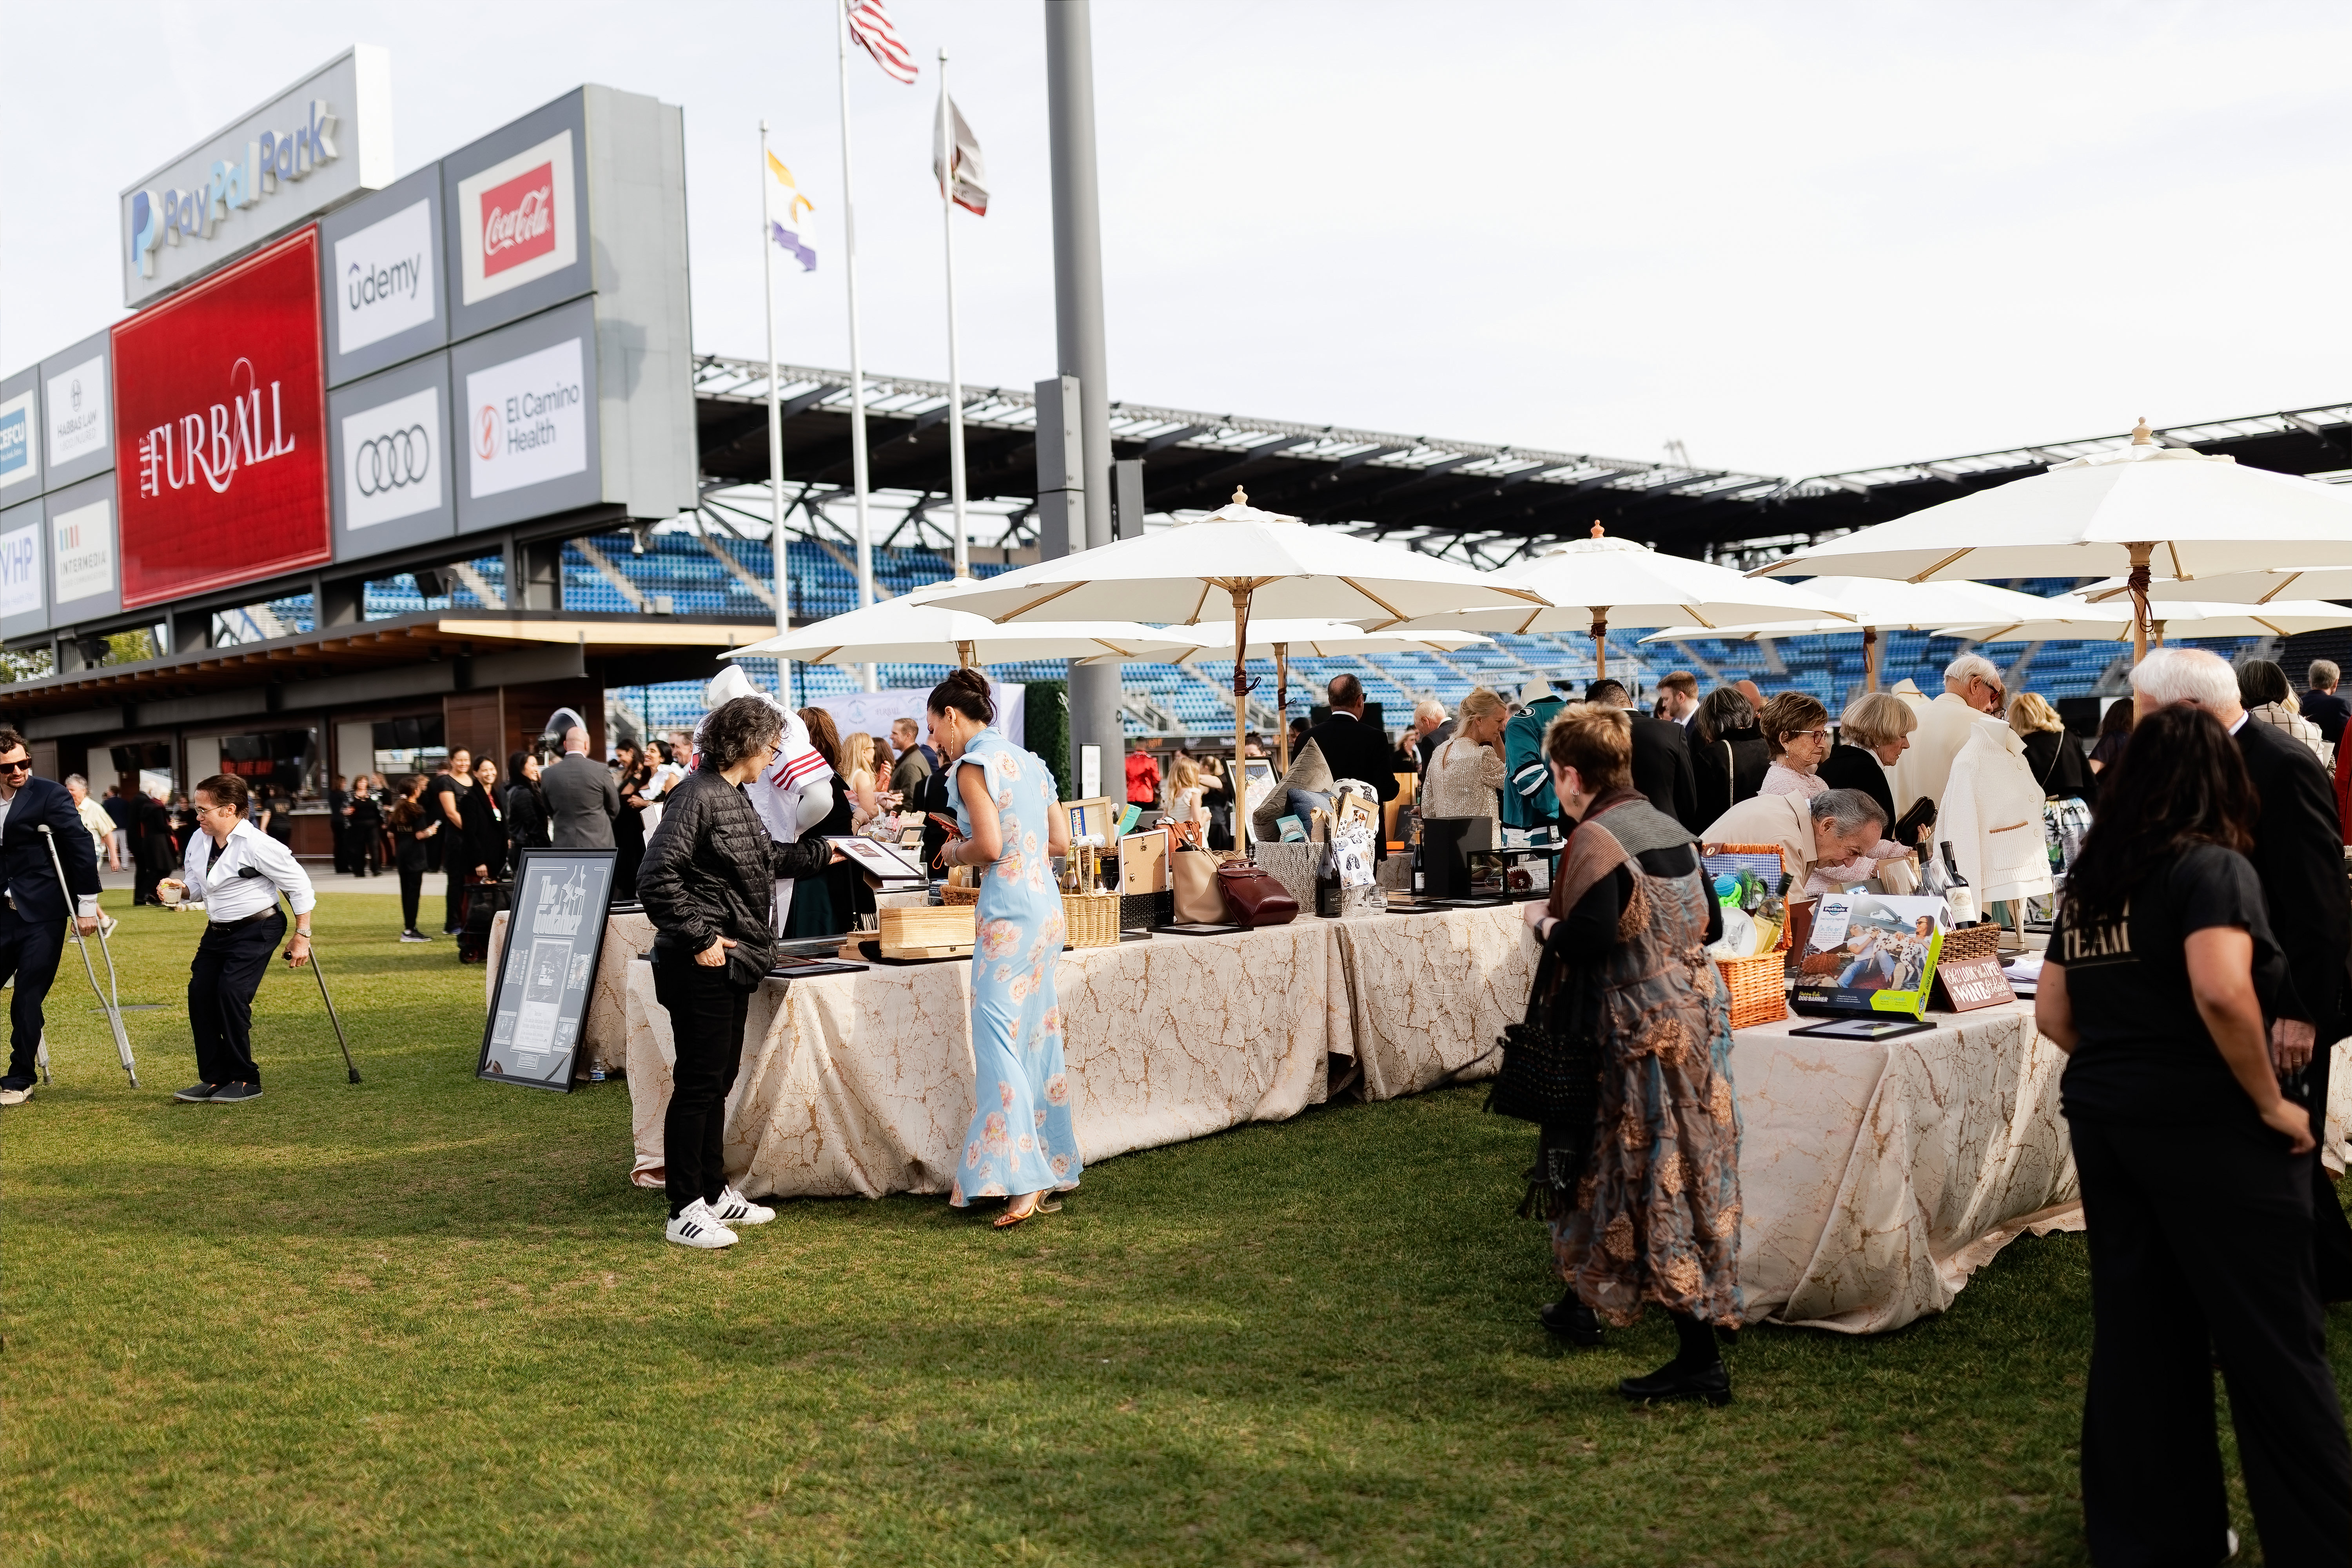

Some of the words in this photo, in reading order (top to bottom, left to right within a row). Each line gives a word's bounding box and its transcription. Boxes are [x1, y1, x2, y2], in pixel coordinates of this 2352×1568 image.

[164, 142, 260, 246] PayPal
[260, 98, 338, 194] Park
[507, 396, 519, 423] El
[523, 382, 578, 417] Camino
[57, 416, 82, 438] HABBAS
[83, 408, 97, 427] LAW
[149, 357, 296, 493] FURBALL
[507, 418, 556, 454] Health
[60, 550, 106, 576] INTERMEDIA
[539, 875, 558, 904] The
[533, 904, 582, 936] Godfather
[2062, 922, 2132, 960] TEAM
[1944, 967, 1962, 984] Oh!
[1961, 965, 1978, 982] LOOK
[1977, 965, 1987, 978] the
[1981, 961, 2001, 977] TIME!
[1952, 981, 1991, 1003] WINE
